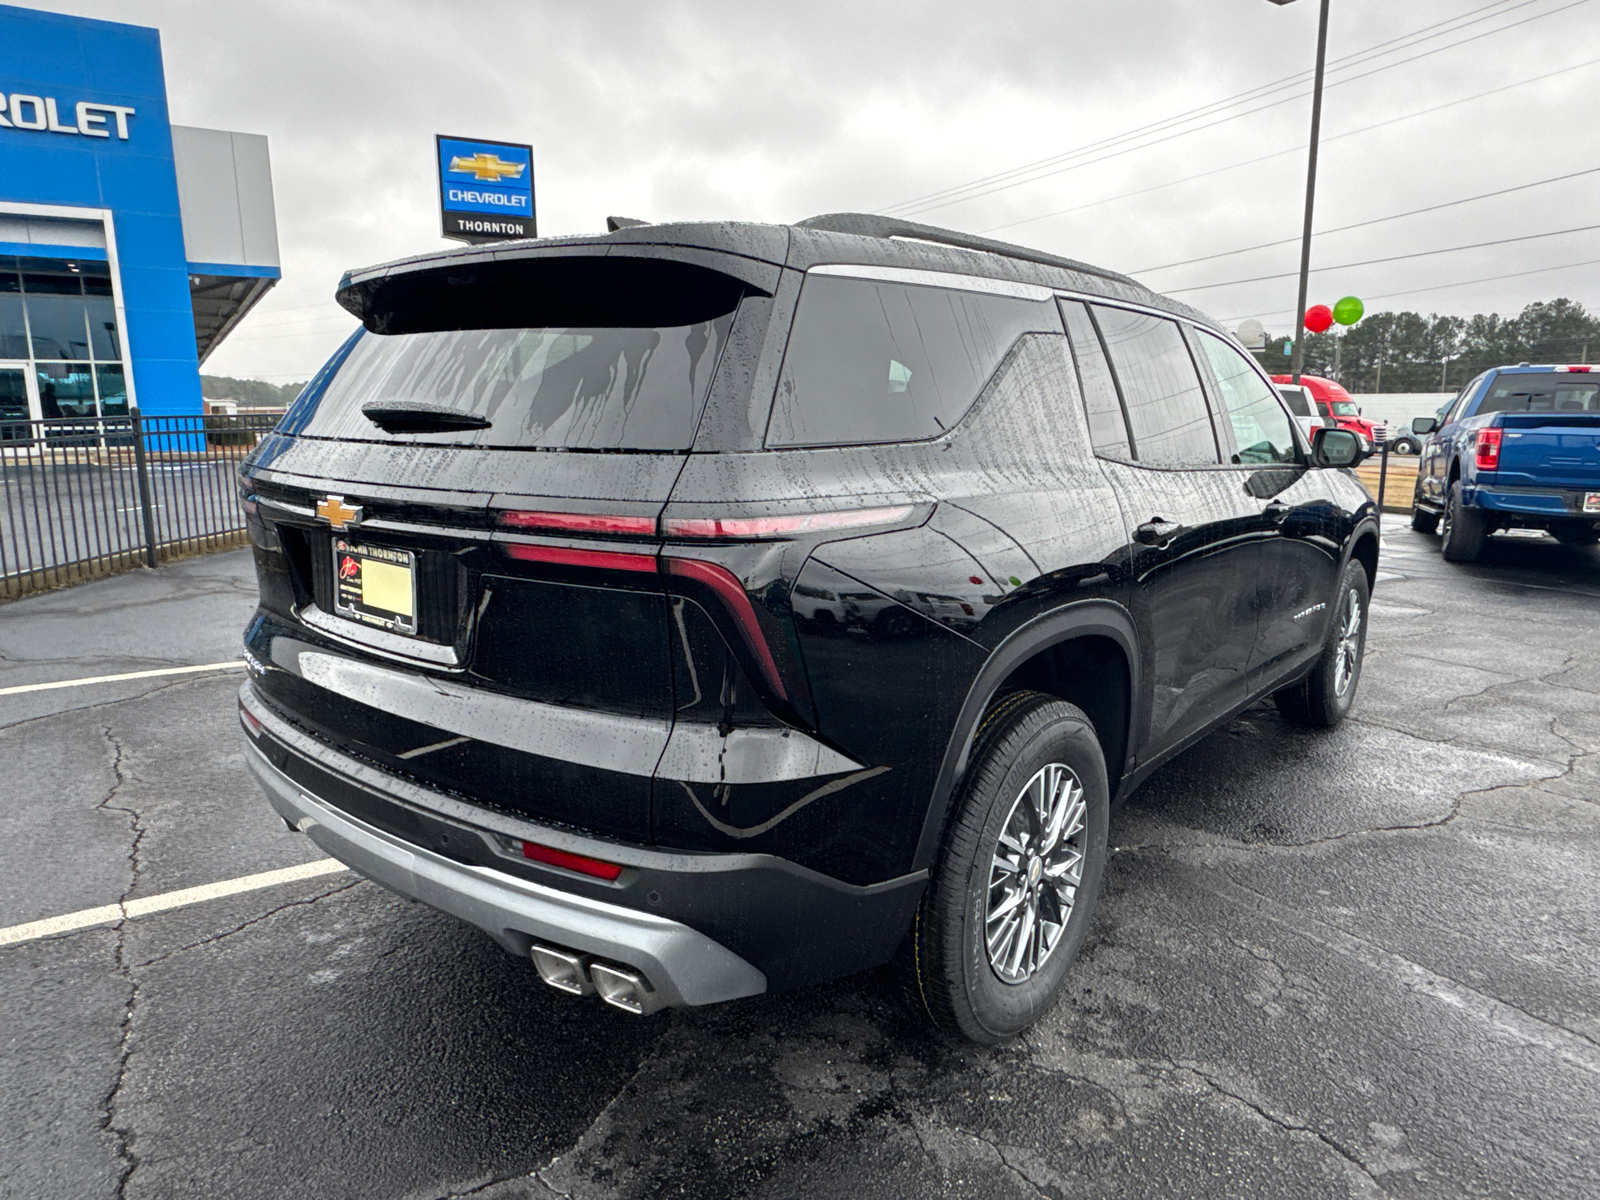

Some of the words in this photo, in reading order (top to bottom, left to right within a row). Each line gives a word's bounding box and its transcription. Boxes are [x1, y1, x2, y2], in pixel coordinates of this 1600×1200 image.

[448, 189, 527, 208] CHEVROLET
[458, 219, 524, 235] THORNTON
[982, 754, 1028, 848] IDGESTONE
